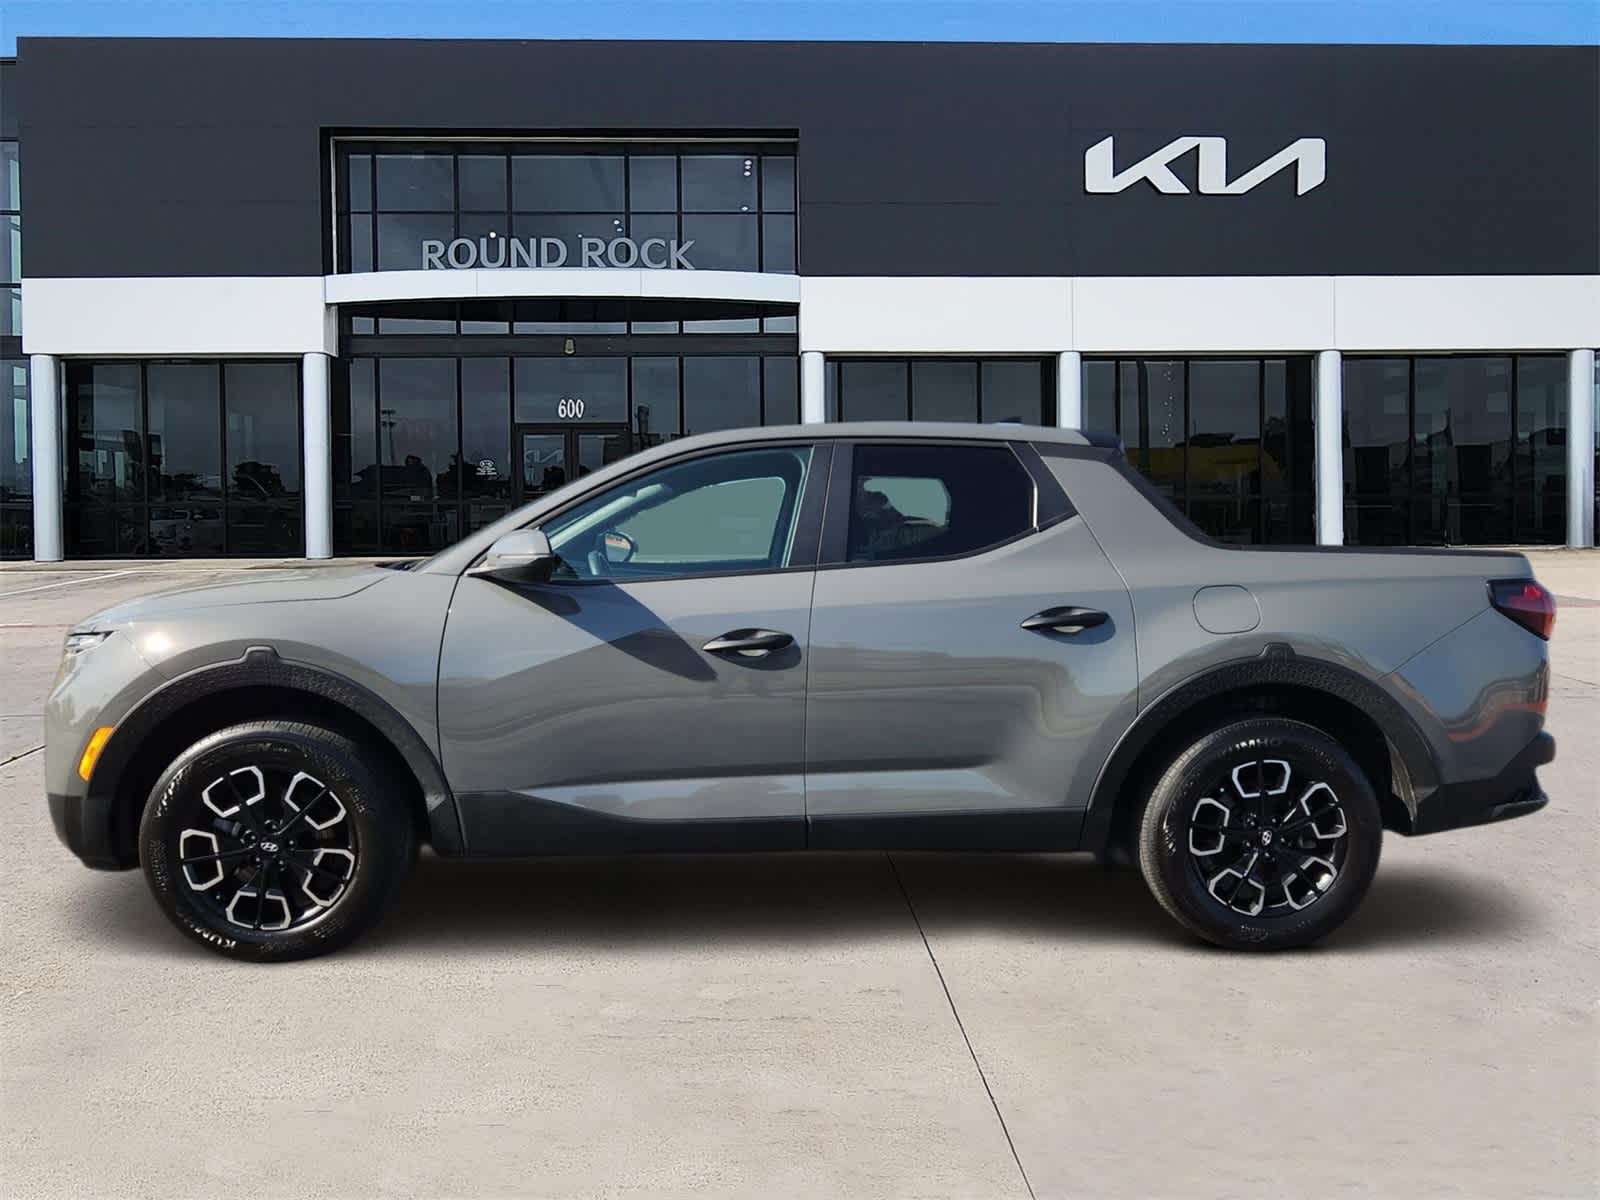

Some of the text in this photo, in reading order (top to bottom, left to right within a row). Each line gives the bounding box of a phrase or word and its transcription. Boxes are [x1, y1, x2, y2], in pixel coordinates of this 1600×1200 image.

[1084, 135, 1326, 196] KIA
[421, 237, 696, 270] ROUND ROCK
[558, 399, 584, 418] 600
